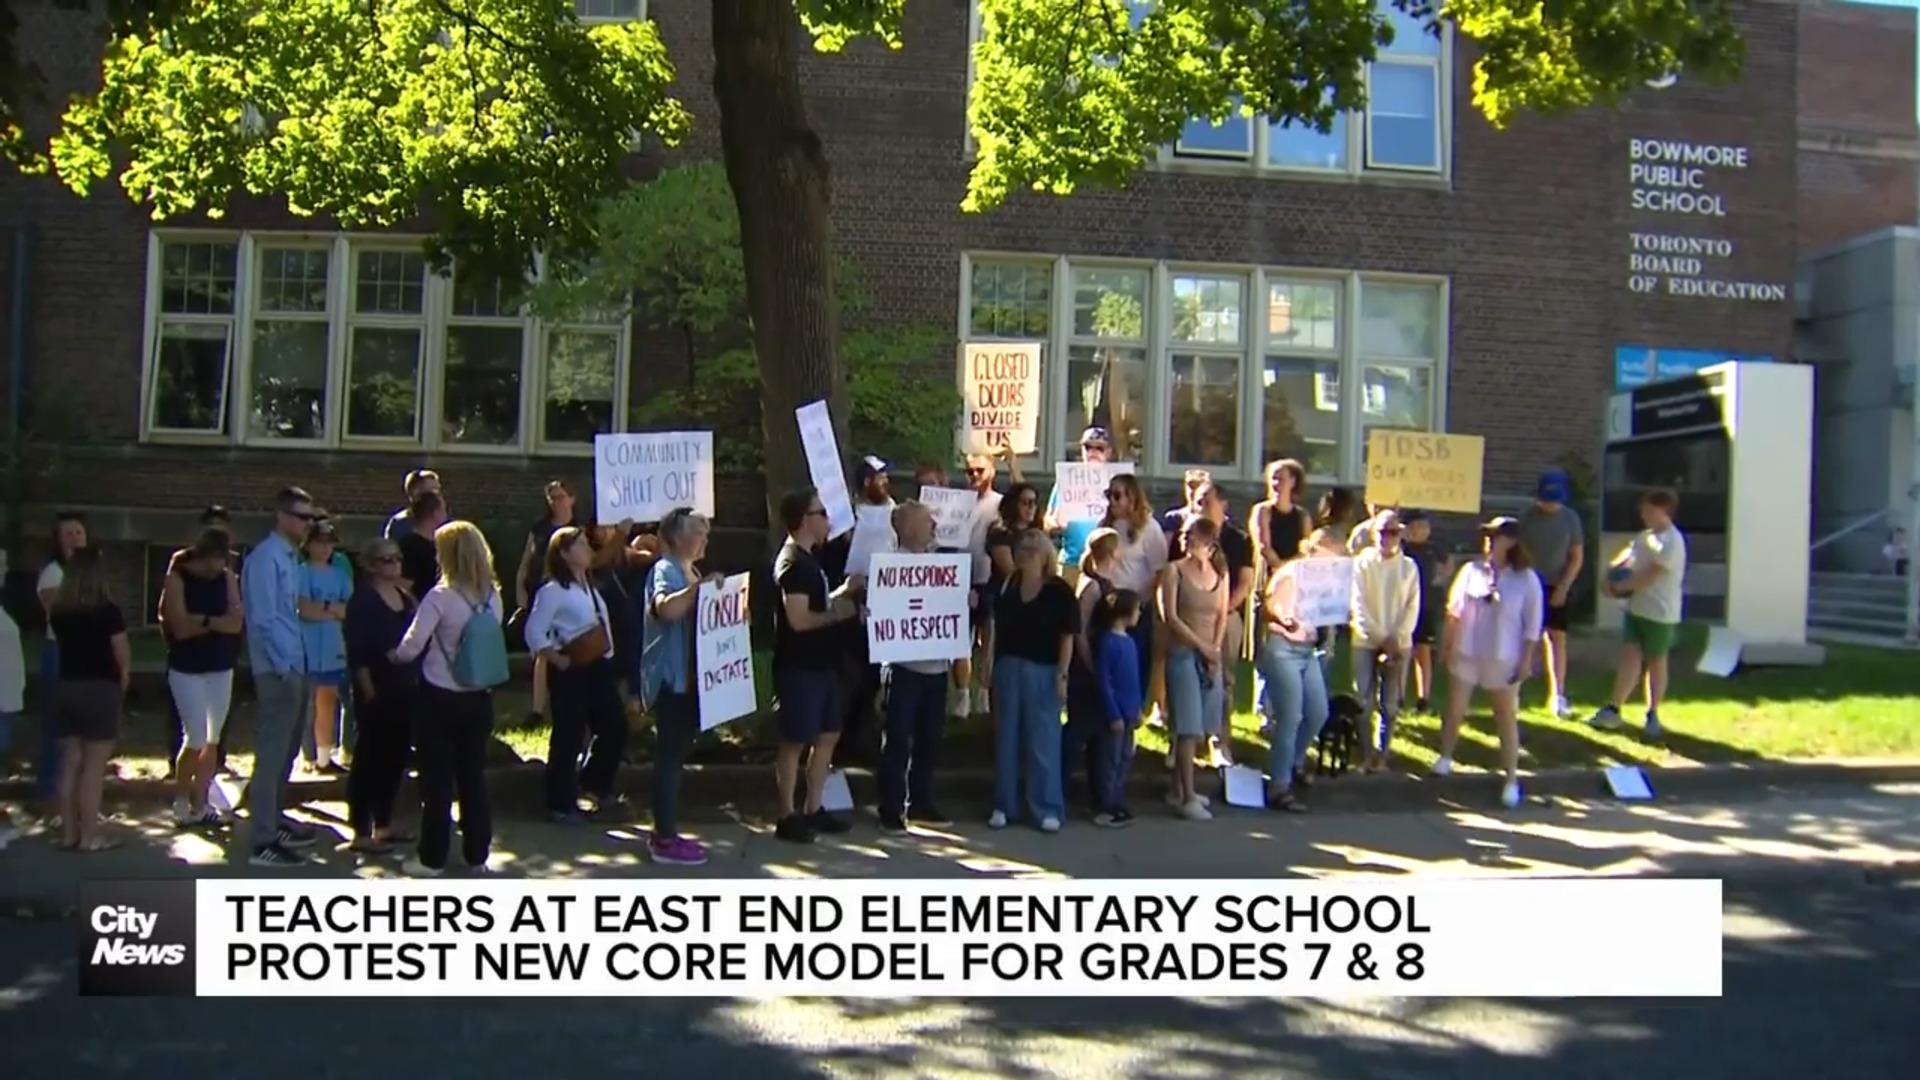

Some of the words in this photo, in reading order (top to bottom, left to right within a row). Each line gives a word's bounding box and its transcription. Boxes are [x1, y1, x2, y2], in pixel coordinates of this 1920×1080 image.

[1629, 138, 1748, 167] BOWMORE
[1630, 164, 1704, 189] PUBLIC
[1631, 188, 1726, 216] SCHOOL
[1629, 232, 1732, 257] TORONTO
[1630, 253, 1701, 275] BOARD
[1629, 275, 1657, 293] OF
[1668, 277, 1786, 300] EDUCATION
[973, 352, 1030, 381] CLOSED
[978, 382, 1025, 409] DOORS
[971, 411, 1022, 427] DIVIDE
[985, 431, 1011, 448] US
[1379, 434, 1451, 461] TDSB
[604, 441, 703, 467] COMMUNITY
[610, 474, 653, 508] SHUT
[663, 470, 697, 501] OUT
[1067, 467, 1100, 487] THIS
[877, 566, 898, 588] NO
[899, 565, 960, 588] RESPONSE
[874, 618, 896, 643] NO
[900, 614, 961, 641] RESPECT
